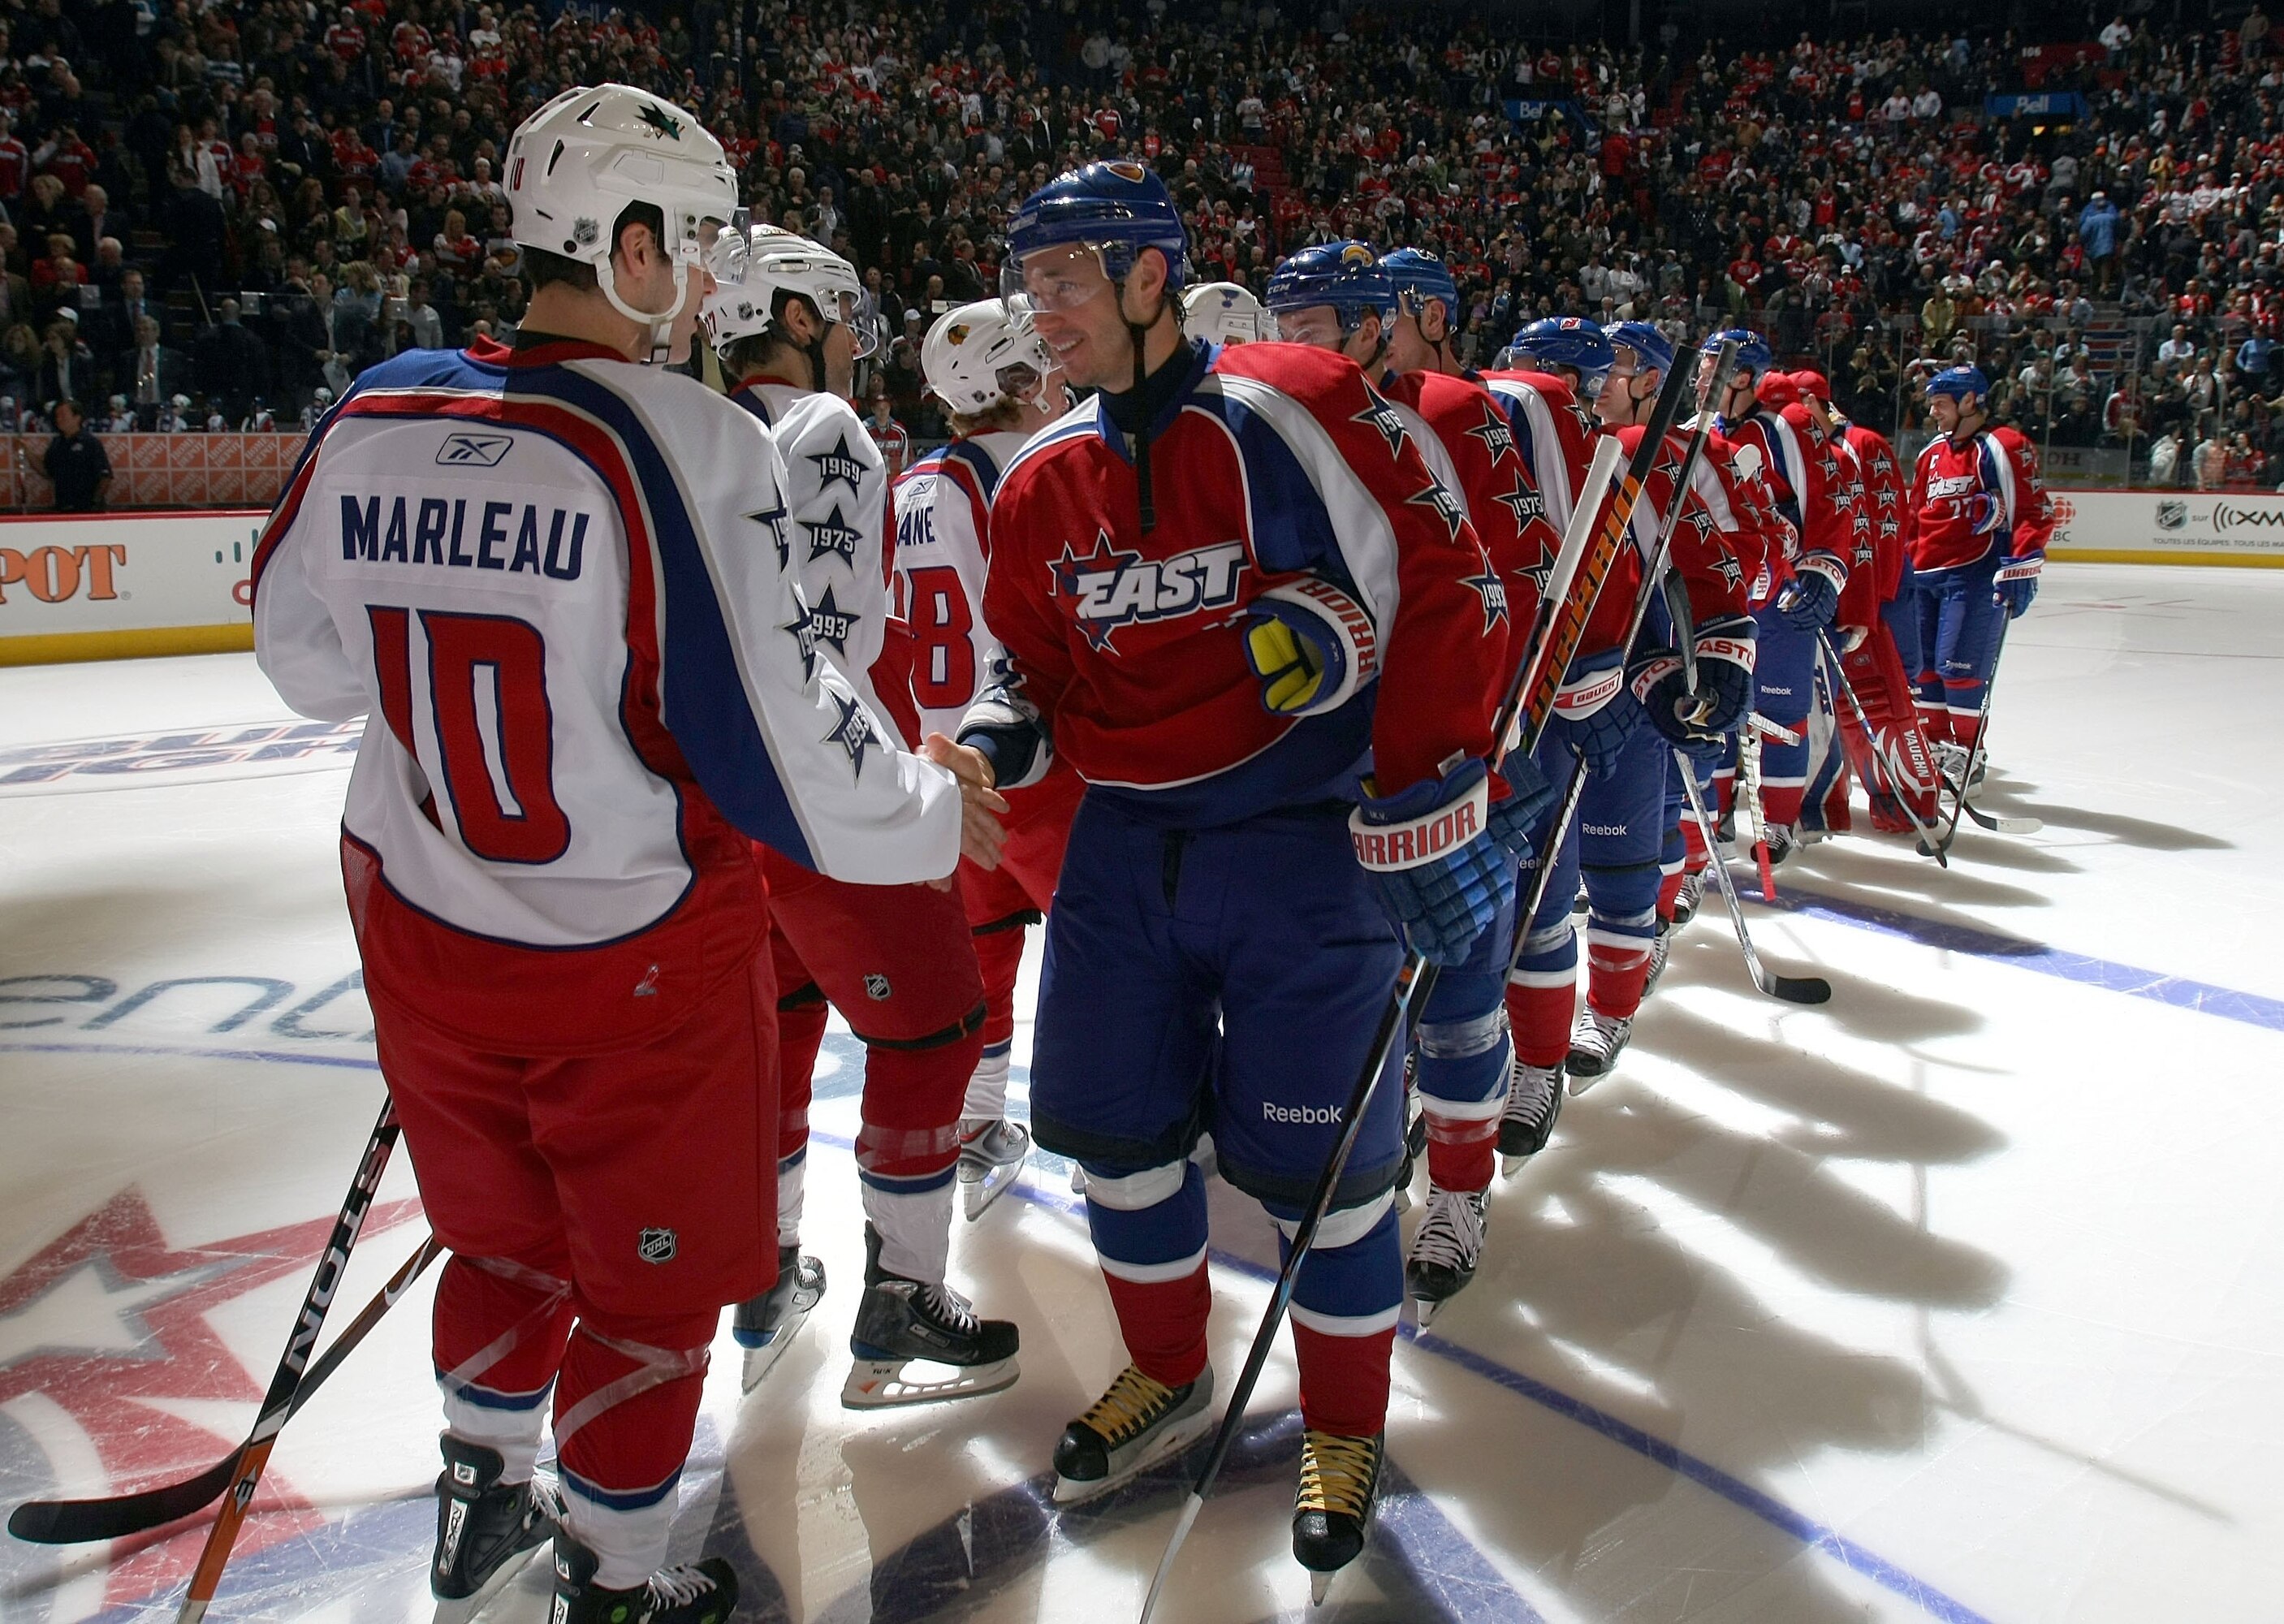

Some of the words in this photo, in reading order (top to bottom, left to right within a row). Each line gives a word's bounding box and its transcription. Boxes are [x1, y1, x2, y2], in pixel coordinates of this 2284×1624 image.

[1484, 427, 1513, 447] 196
[821, 456, 861, 486] 1969
[1927, 477, 1975, 499] EAST
[1513, 496, 1545, 516] 1975
[340, 495, 589, 581] MARLEAU
[813, 525, 855, 554] 1975
[896, 505, 935, 547] ANE
[2053, 530, 2071, 542] BC
[0, 544, 127, 605] POT
[1073, 540, 1248, 621] EAST
[813, 613, 848, 640] 993
[1576, 680, 1615, 704] BAUER
[1760, 685, 1792, 696] Reebok
[365, 604, 571, 865] 10
[1903, 728, 1930, 778] VAUGHN
[1351, 801, 1478, 865] ARRIOR
[1582, 823, 1627, 836] Reebok
[1263, 1101, 1342, 1125] Reebok
[286, 1137, 391, 1368] STON
[646, 1237, 670, 1255] NHL
